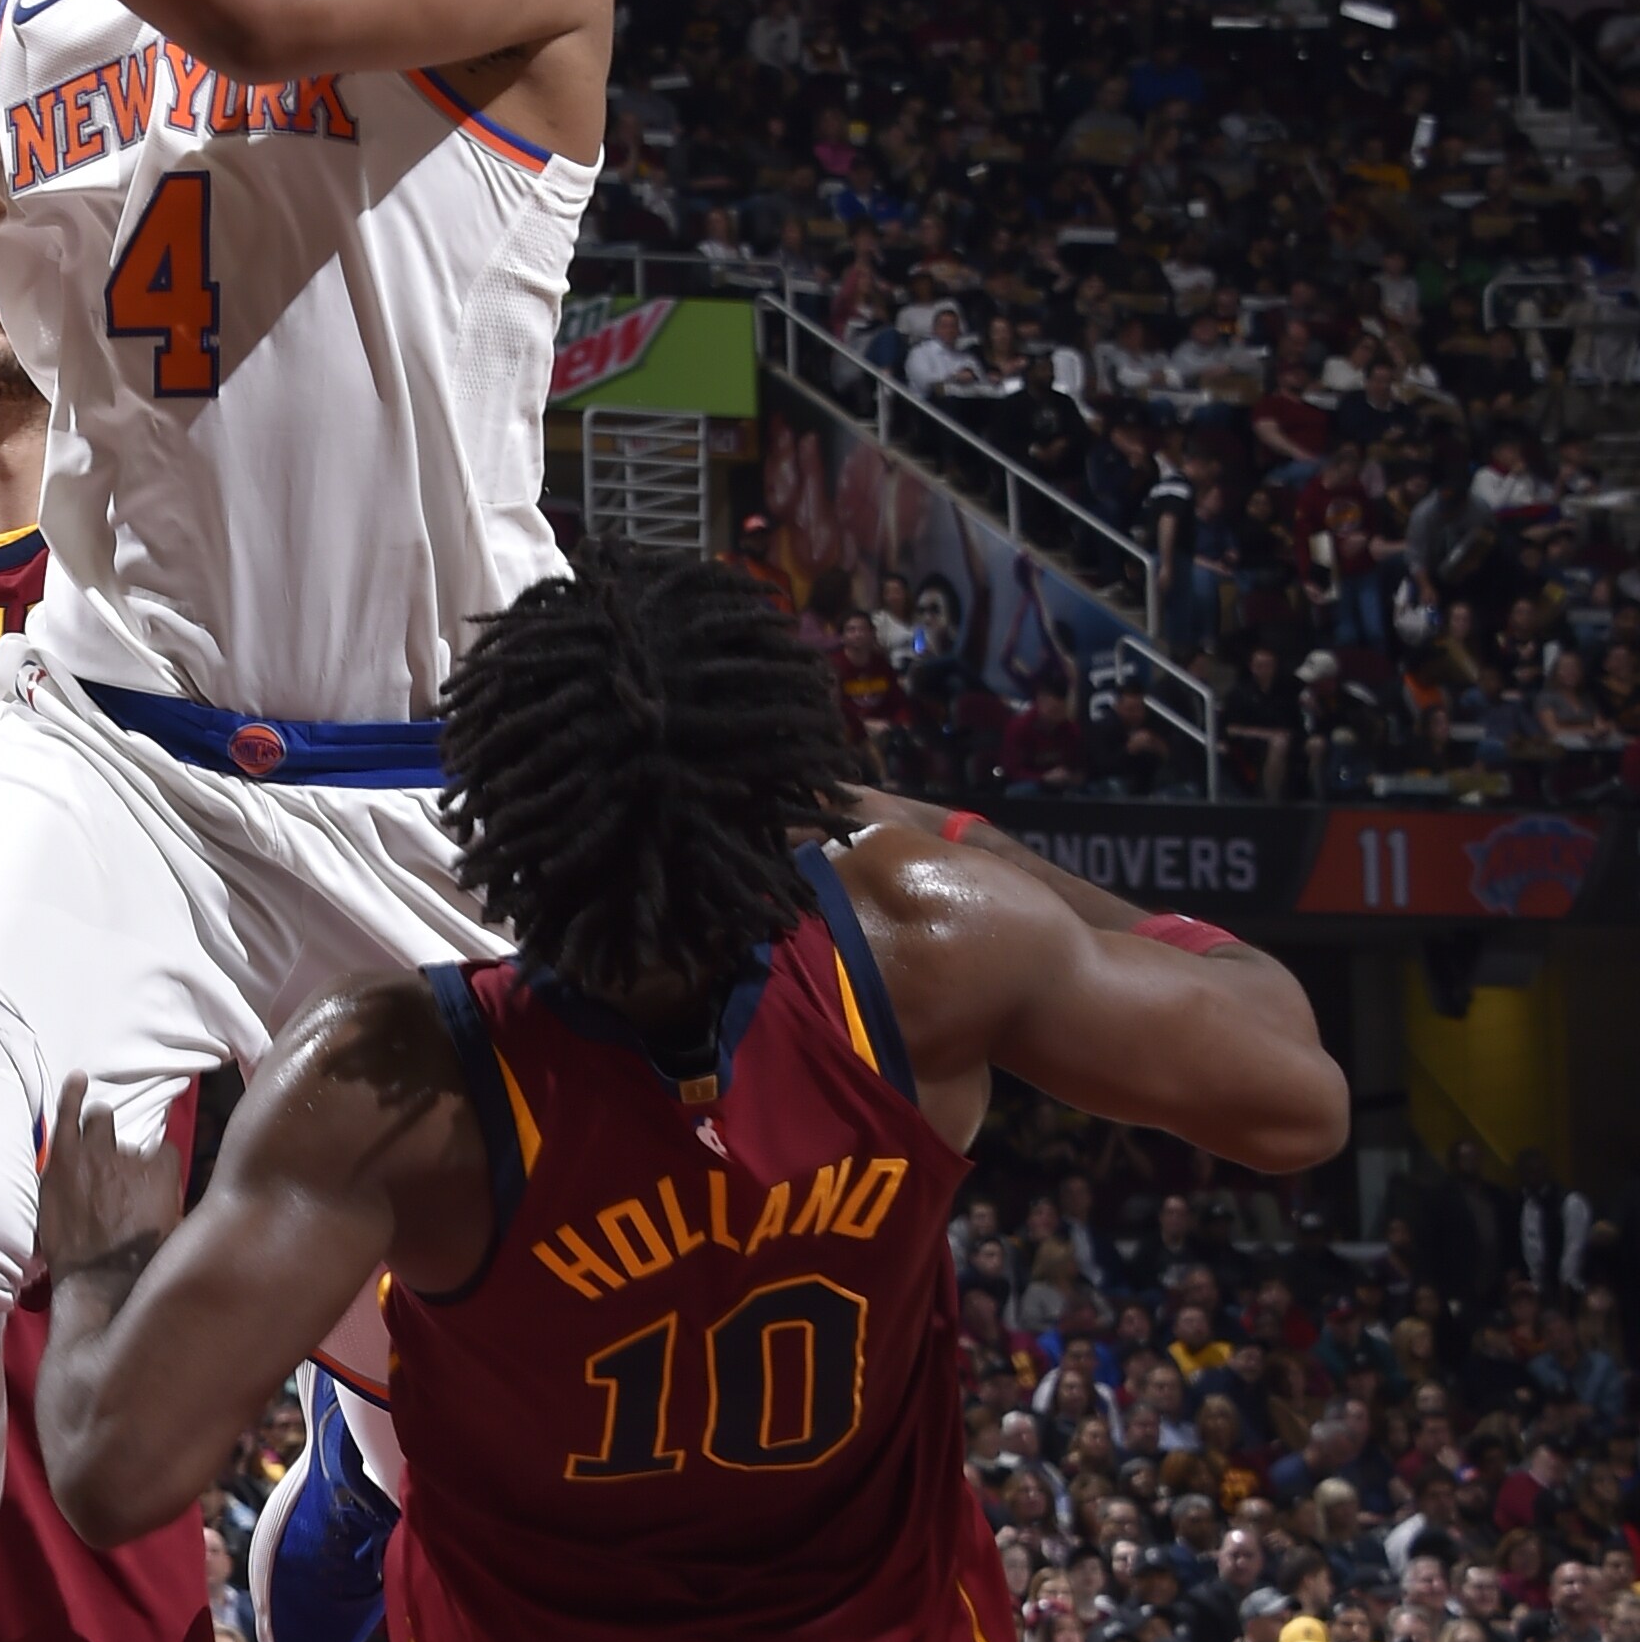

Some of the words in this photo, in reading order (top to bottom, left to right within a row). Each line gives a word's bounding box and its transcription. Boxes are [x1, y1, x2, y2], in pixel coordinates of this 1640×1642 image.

[5, 39, 160, 199] NEW
[106, 171, 221, 399] 4
[1360, 828, 1410, 908] 11
[530, 1154, 910, 1302] HOLLAND
[562, 1270, 870, 1483] 10
